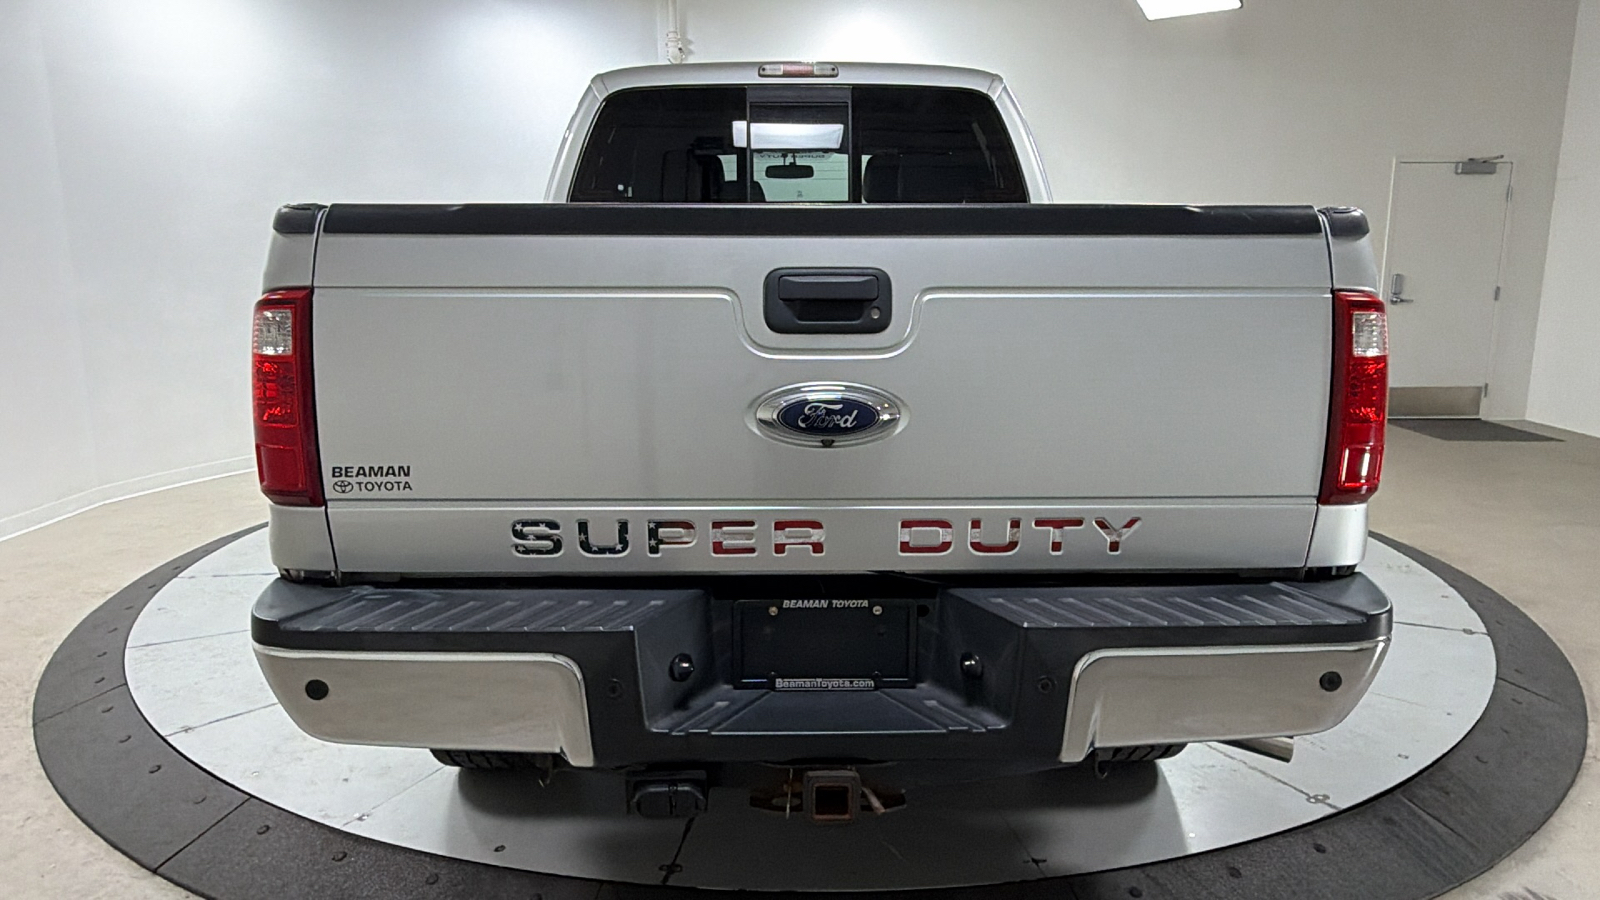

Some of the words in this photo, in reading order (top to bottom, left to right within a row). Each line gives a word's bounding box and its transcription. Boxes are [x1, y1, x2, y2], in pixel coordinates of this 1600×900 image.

[797, 402, 859, 429] Ford
[331, 465, 411, 478] BEAMAN
[355, 481, 413, 492] TOYOTA
[511, 518, 826, 557] SUPER
[898, 517, 1142, 556] DUTY
[782, 599, 829, 608] BEAMAN
[831, 599, 869, 608] TOYOTA
[775, 678, 875, 689] BeamanToyota.com
